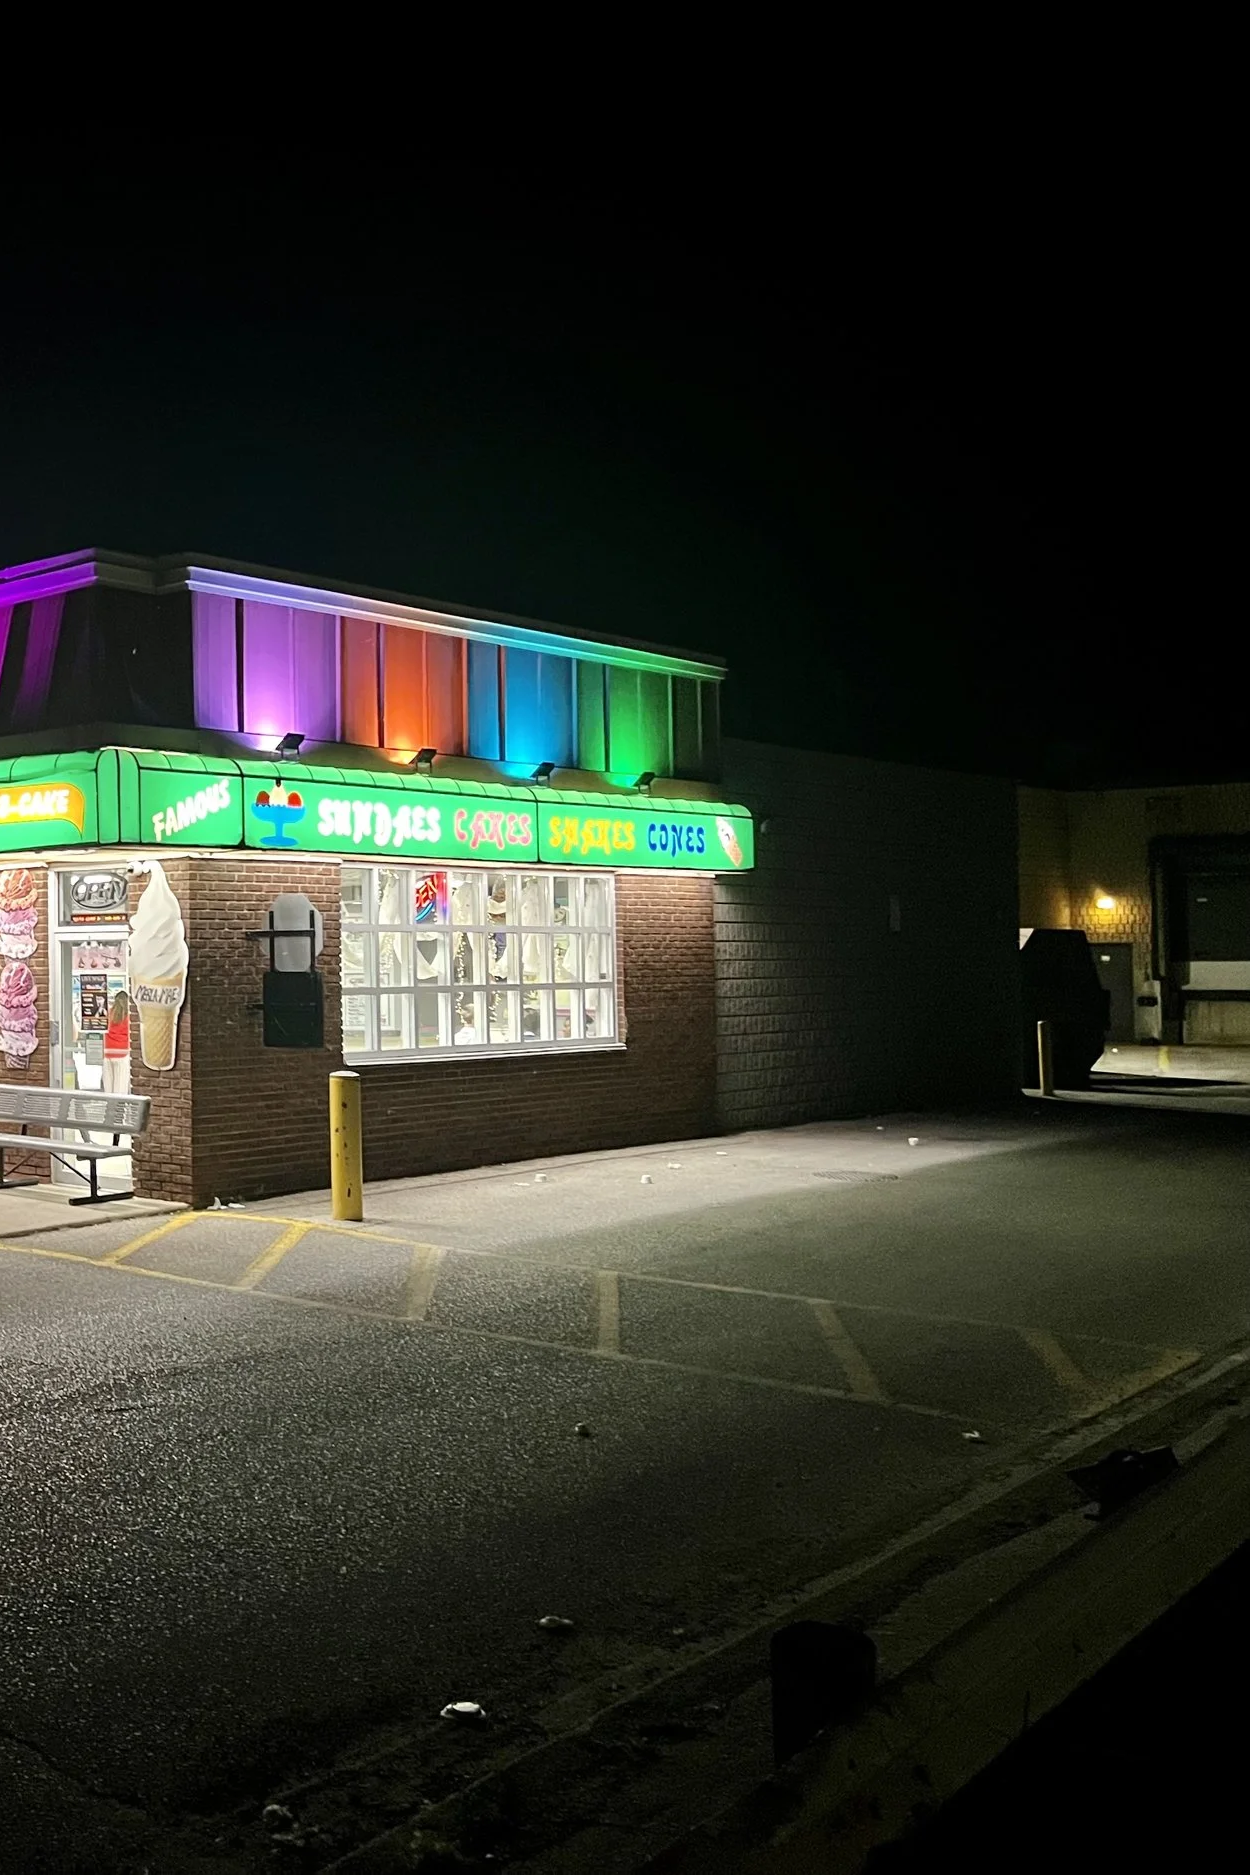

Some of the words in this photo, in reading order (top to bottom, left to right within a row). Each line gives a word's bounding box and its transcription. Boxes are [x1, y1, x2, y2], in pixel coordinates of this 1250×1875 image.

[152, 778, 231, 841] FAMOUS
[317, 798, 441, 846] SUNDAES
[453, 809, 533, 850] CAKES
[549, 815, 636, 855] SHAKES
[647, 824, 705, 858] CONES
[73, 878, 128, 901] OPEN
